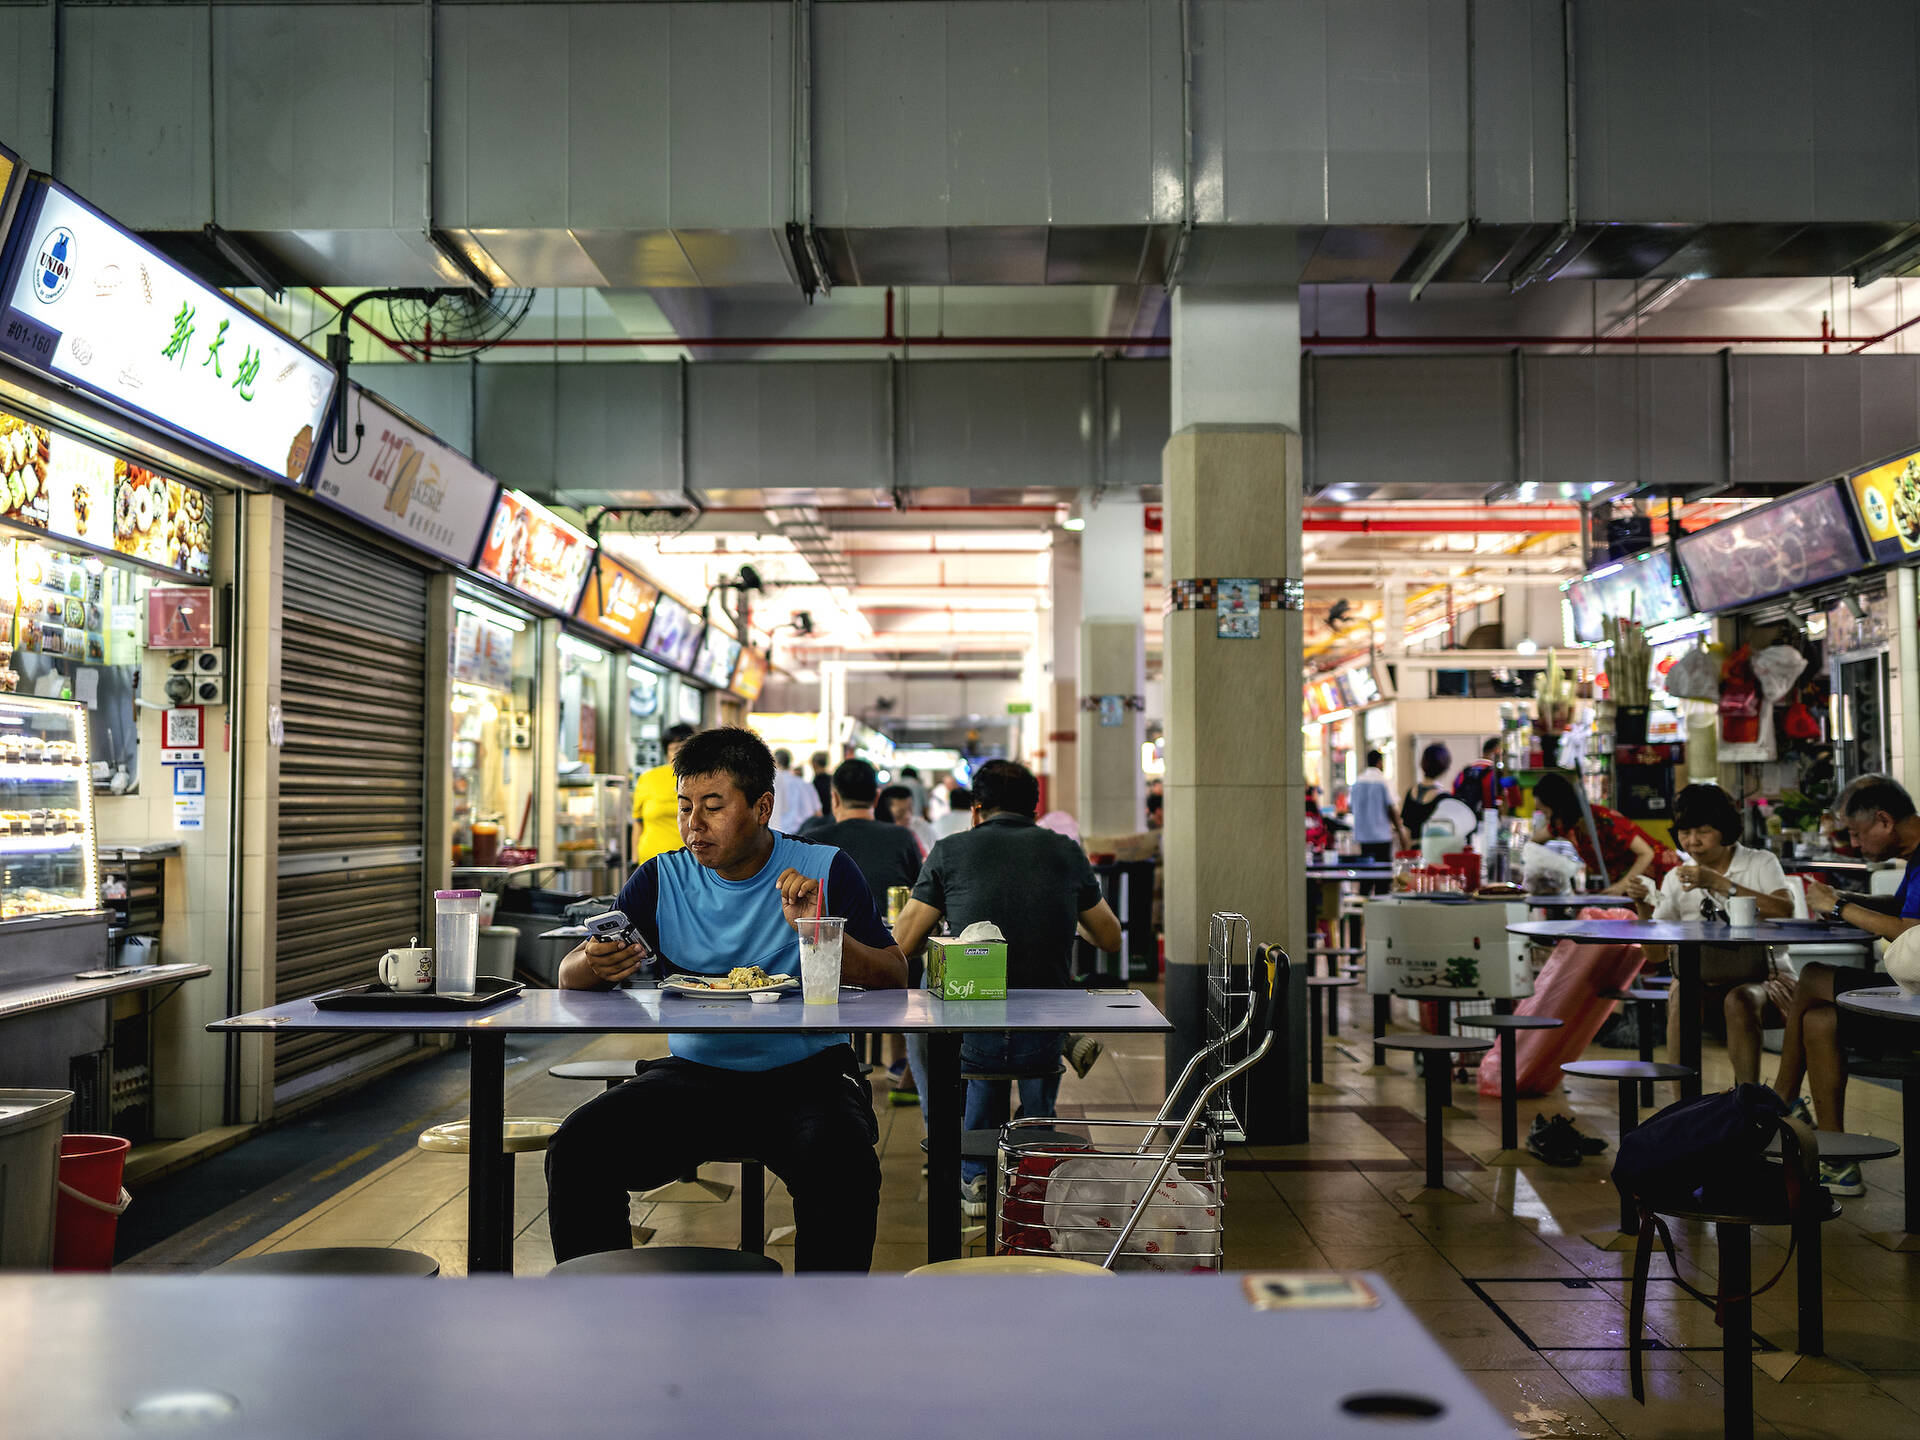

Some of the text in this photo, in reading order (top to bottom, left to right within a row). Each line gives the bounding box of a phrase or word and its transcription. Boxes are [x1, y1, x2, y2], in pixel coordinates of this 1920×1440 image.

[40, 251, 71, 280] UNION
[6, 319, 51, 355] #01-160
[161, 300, 261, 402] 新天地
[164, 605, 194, 633] A
[964, 948, 989, 956] FairPrice
[946, 979, 975, 999] Soft
